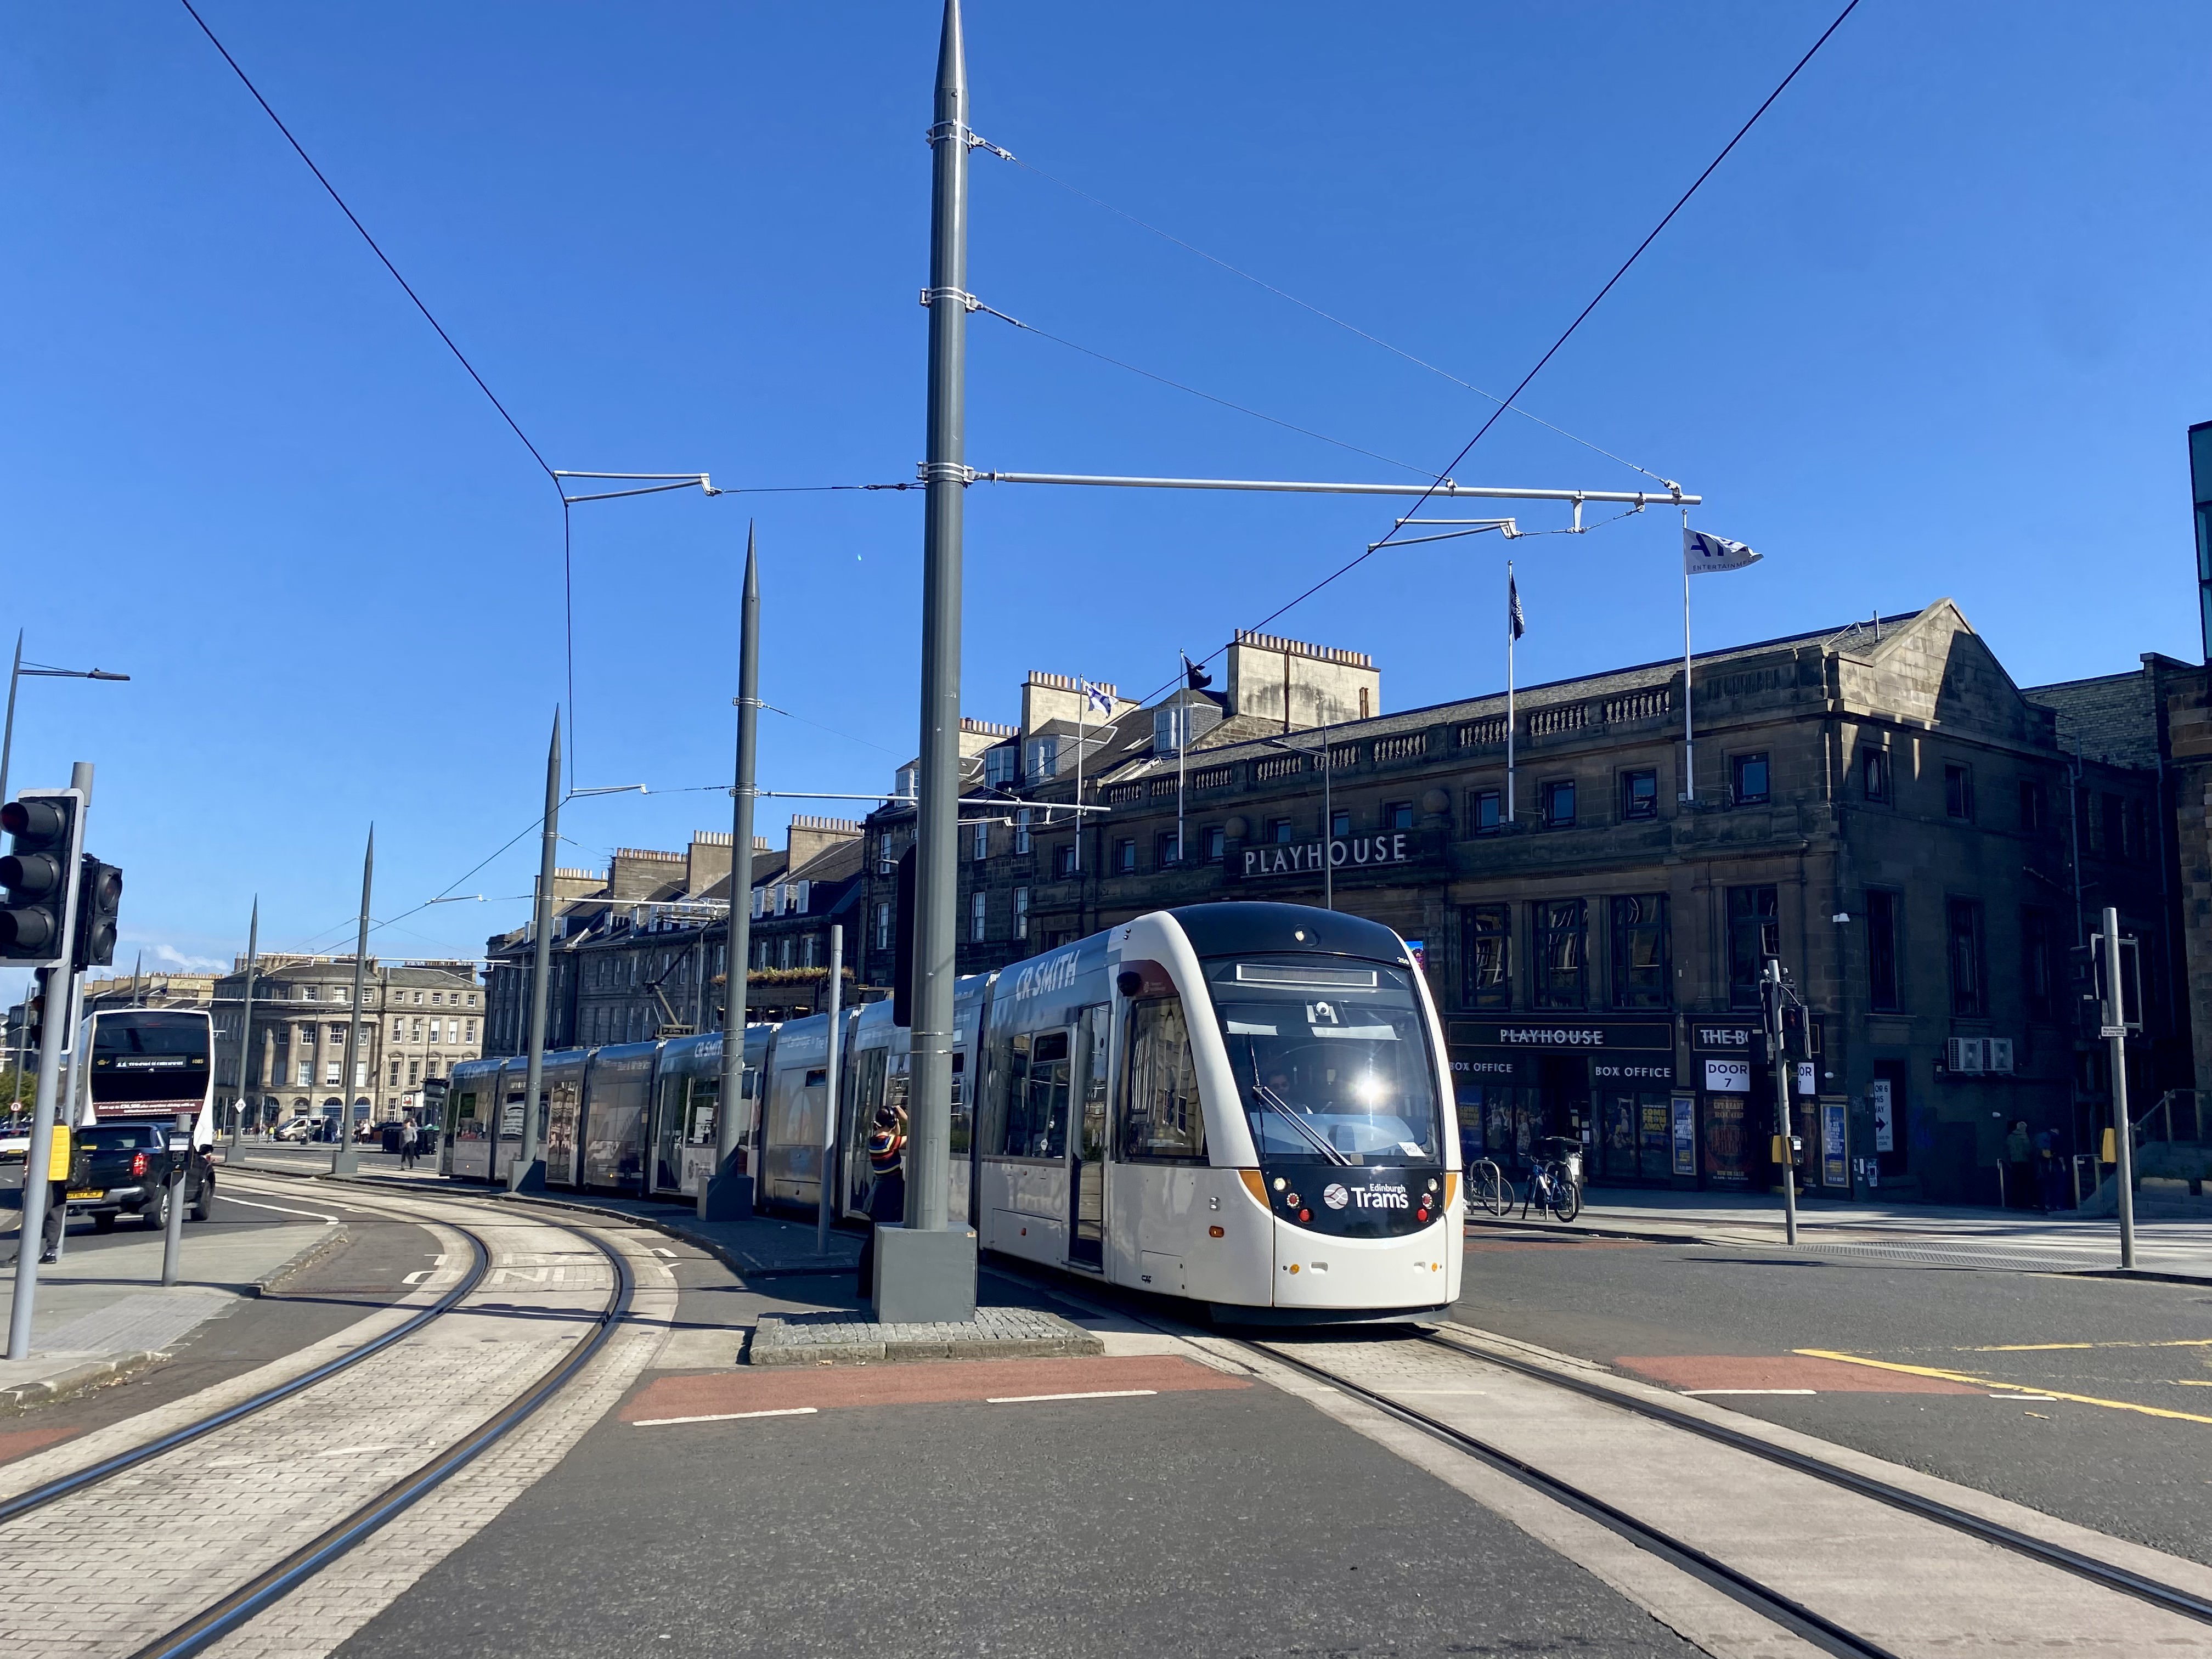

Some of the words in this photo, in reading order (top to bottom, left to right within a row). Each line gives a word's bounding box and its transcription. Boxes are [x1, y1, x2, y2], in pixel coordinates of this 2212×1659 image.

[1245, 834, 1406, 874] PLAYHOUSE
[1032, 949, 1081, 996] SMITH
[1500, 1029, 1604, 1045] PLAYHOUSE
[1700, 1029, 1732, 1044] THE
[1449, 1062, 1470, 1071] BOX
[1473, 1063, 1514, 1073] OFFICE
[1595, 1066, 1620, 1076] BOX
[1624, 1067, 1672, 1077] OFFICE
[1708, 1064, 1747, 1074] DOOR
[1724, 1078, 1732, 1087] 7
[1643, 1123, 1666, 1131] AWAY
[1369, 1183, 1406, 1194] Edinburgh
[1351, 1187, 1409, 1209] Trams
